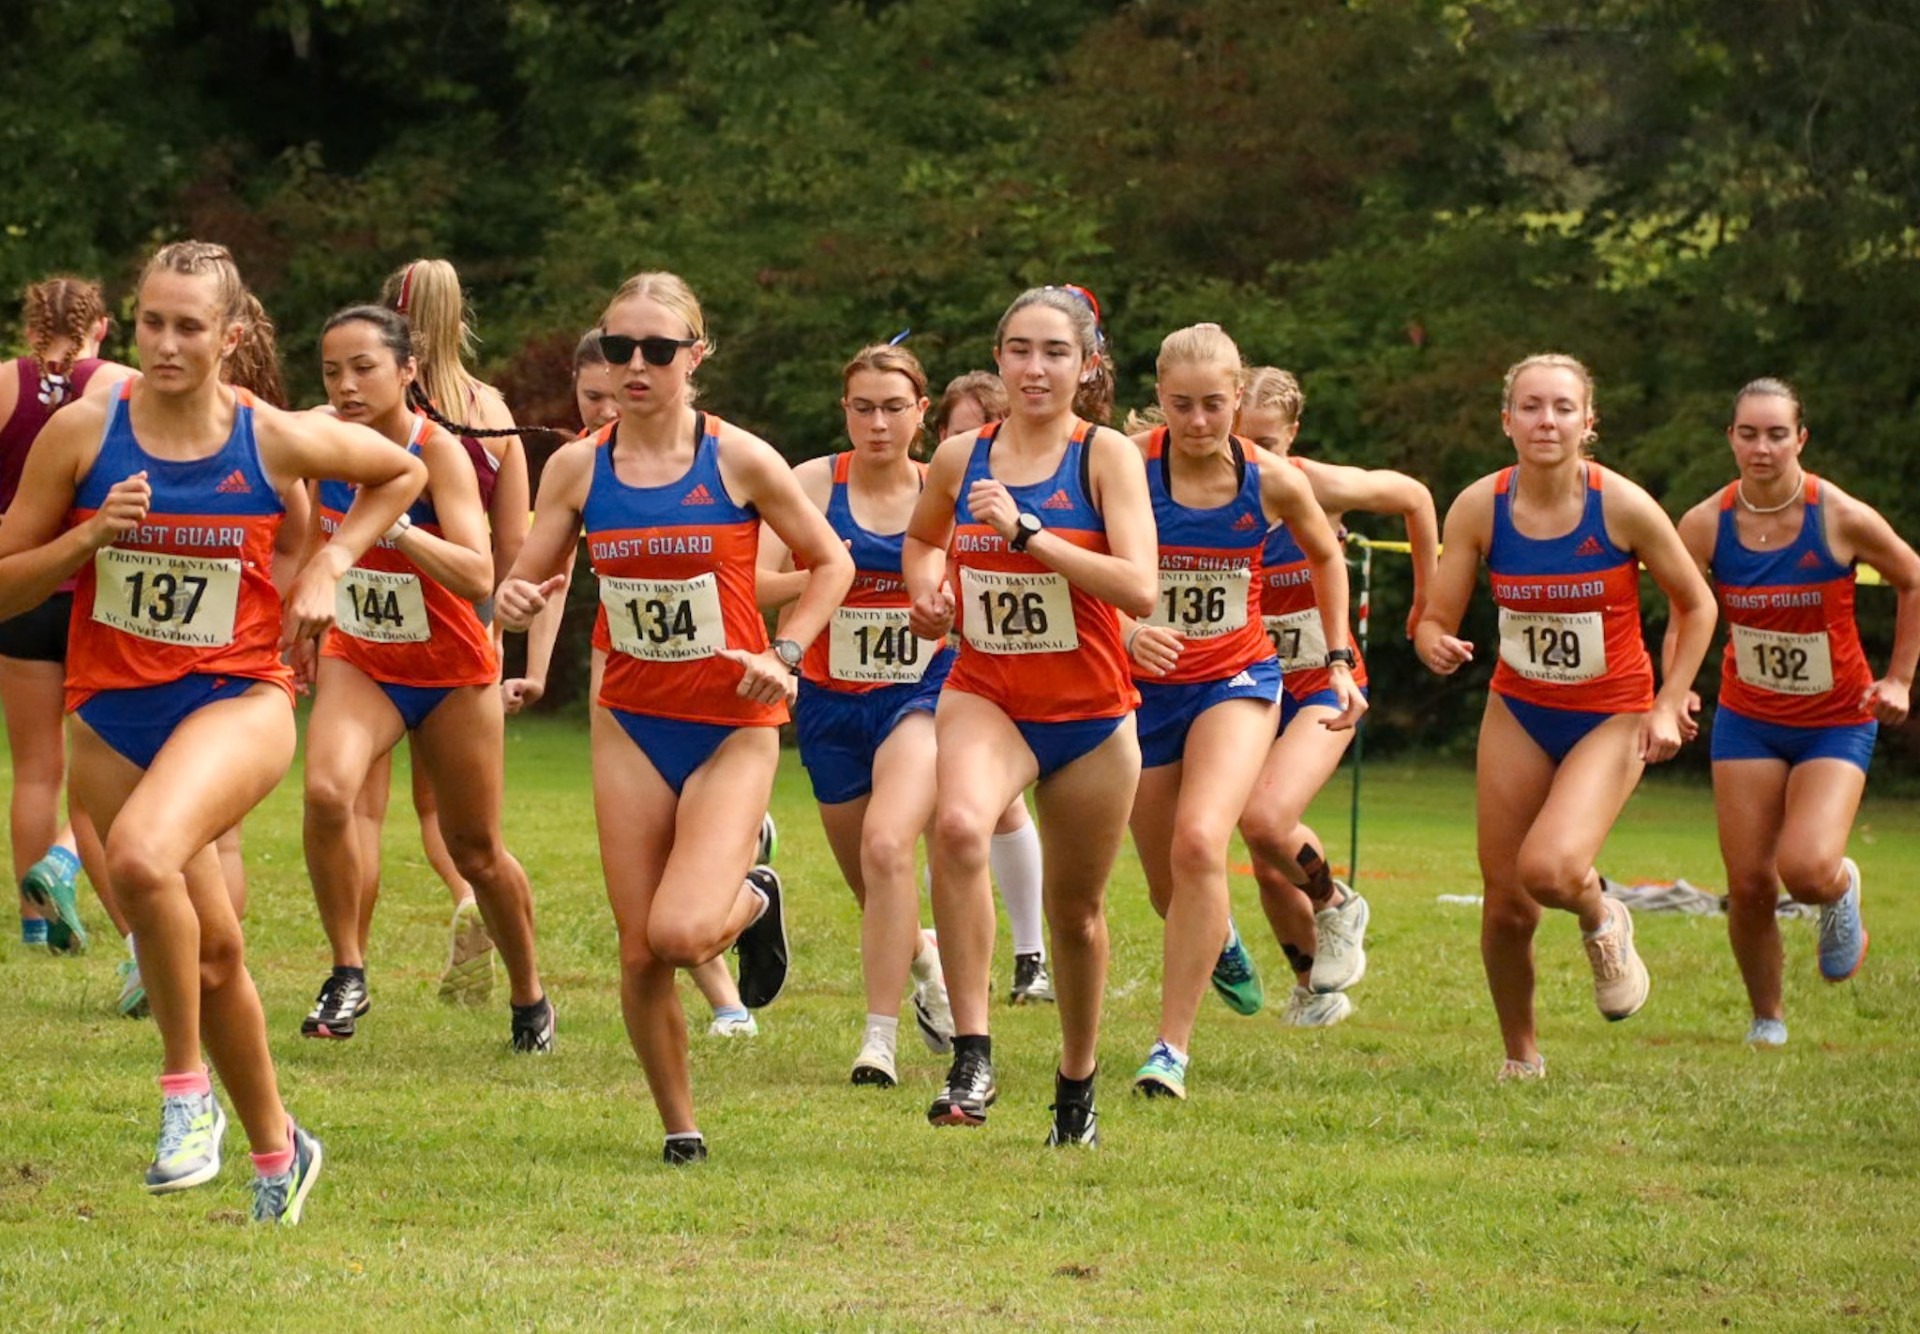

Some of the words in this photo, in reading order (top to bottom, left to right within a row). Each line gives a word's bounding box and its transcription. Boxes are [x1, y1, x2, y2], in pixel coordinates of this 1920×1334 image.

[174, 527, 245, 547] GUARD
[956, 534, 1003, 552] COAST
[591, 538, 642, 561] COAST
[648, 535, 713, 555] GUARD
[107, 550, 163, 568] TRINITY
[168, 556, 229, 573] BANTAM
[1158, 554, 1195, 570] AST
[607, 579, 650, 593] TRINITY
[654, 580, 706, 594] BANTAM
[966, 569, 1001, 585] TRINITY
[1005, 576, 1056, 586] BANTAM
[1269, 568, 1312, 588] GUAR
[126, 570, 208, 625] 137
[1495, 583, 1544, 600] COAST
[1547, 580, 1605, 600] GUARD
[1725, 593, 1769, 609] COAST
[1771, 591, 1822, 608] GUARD
[346, 583, 404, 627] 144
[840, 609, 880, 620] TRINITY
[885, 611, 908, 620] BAN
[979, 590, 1048, 635] 126
[1162, 586, 1226, 624] 136
[104, 611, 122, 626] XC
[124, 616, 219, 644] INVITATIONAL
[625, 598, 697, 644] 134
[1505, 612, 1545, 623] TRINITY
[1548, 615, 1593, 626] BANTAM
[853, 625, 918, 666] 140
[984, 640, 1067, 652] INVITATIONAL
[1265, 628, 1301, 660] 27
[1522, 626, 1581, 669] 129
[1752, 643, 1809, 681] 132
[855, 671, 922, 680] INVITATION
